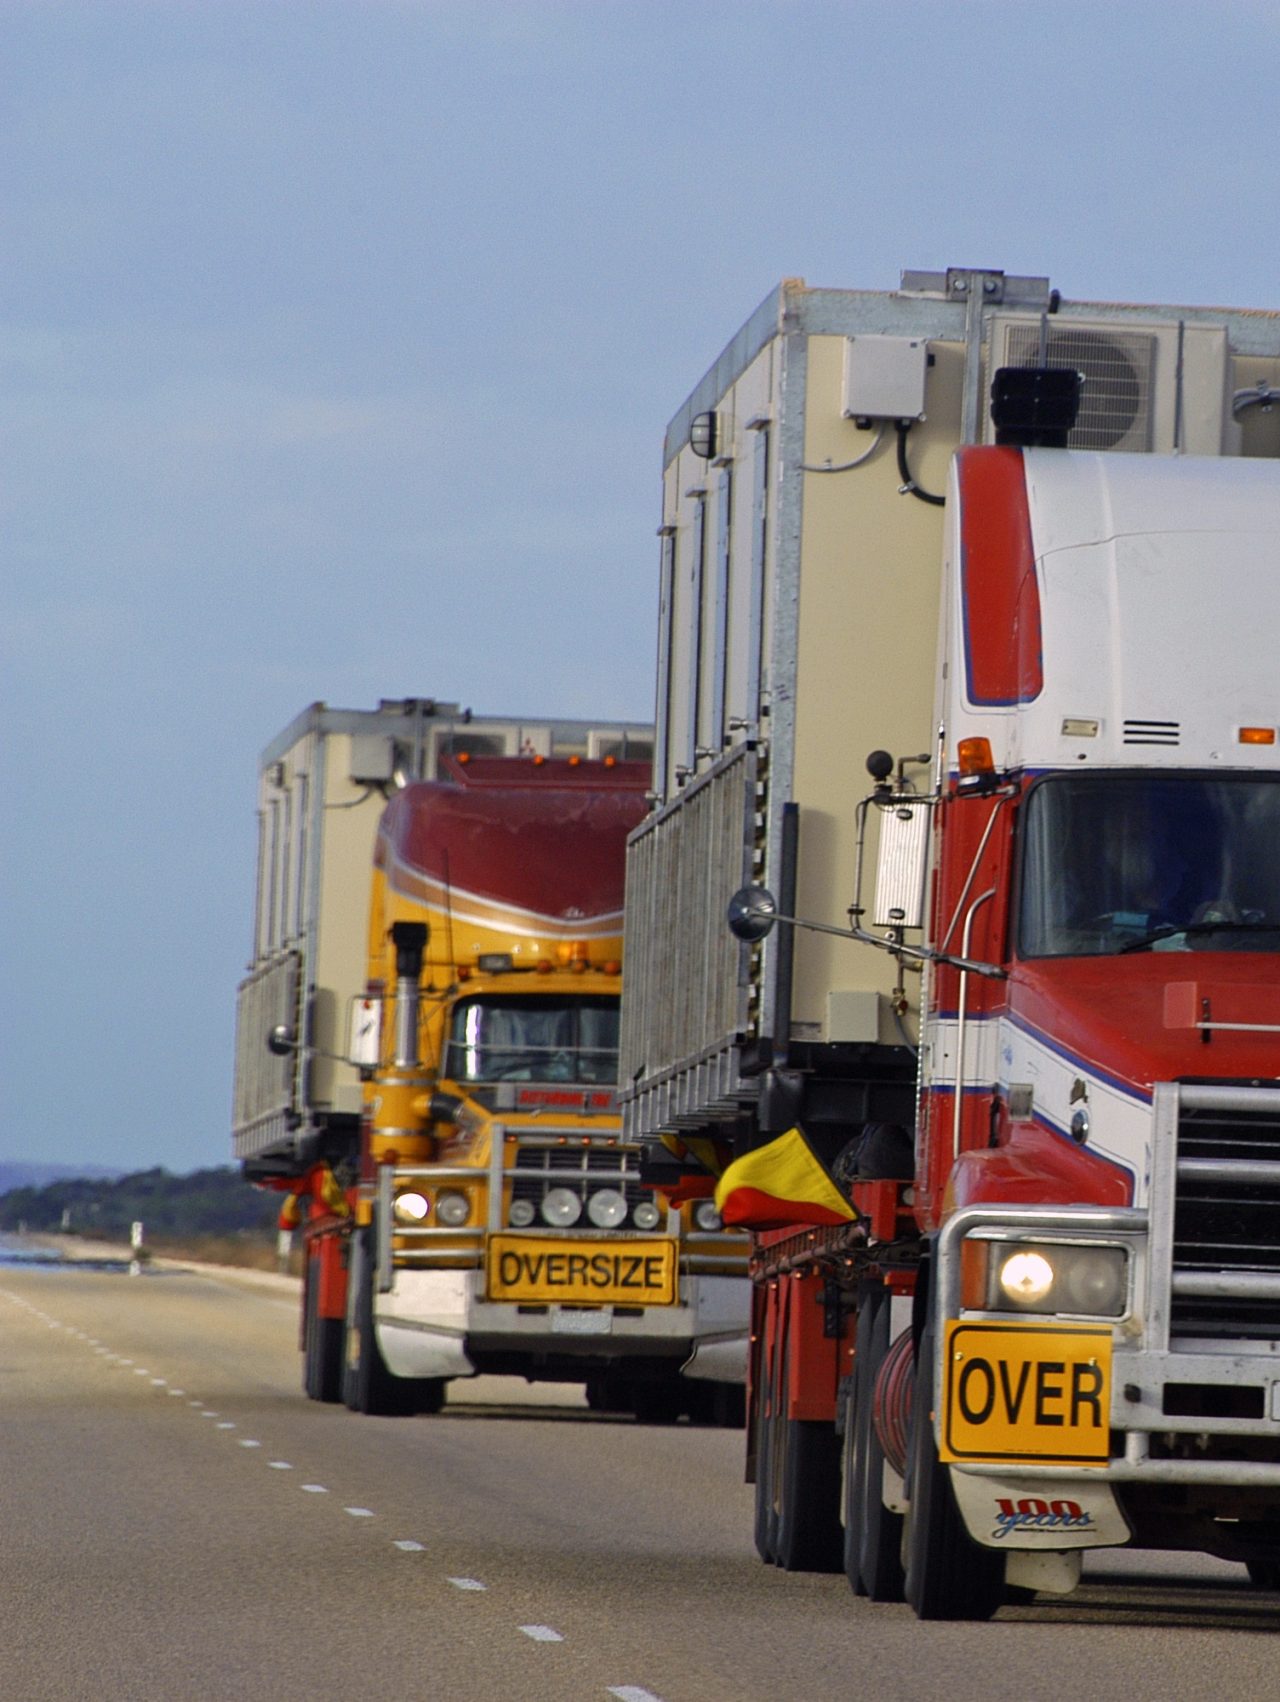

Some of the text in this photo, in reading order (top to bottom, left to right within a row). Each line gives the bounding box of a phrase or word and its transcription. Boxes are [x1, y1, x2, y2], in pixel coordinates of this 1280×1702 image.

[500, 1251, 664, 1289] OVERSIZE
[958, 1357, 1103, 1428] OVER
[992, 1511, 1095, 1538] years
[994, 1498, 1083, 1520] 100
